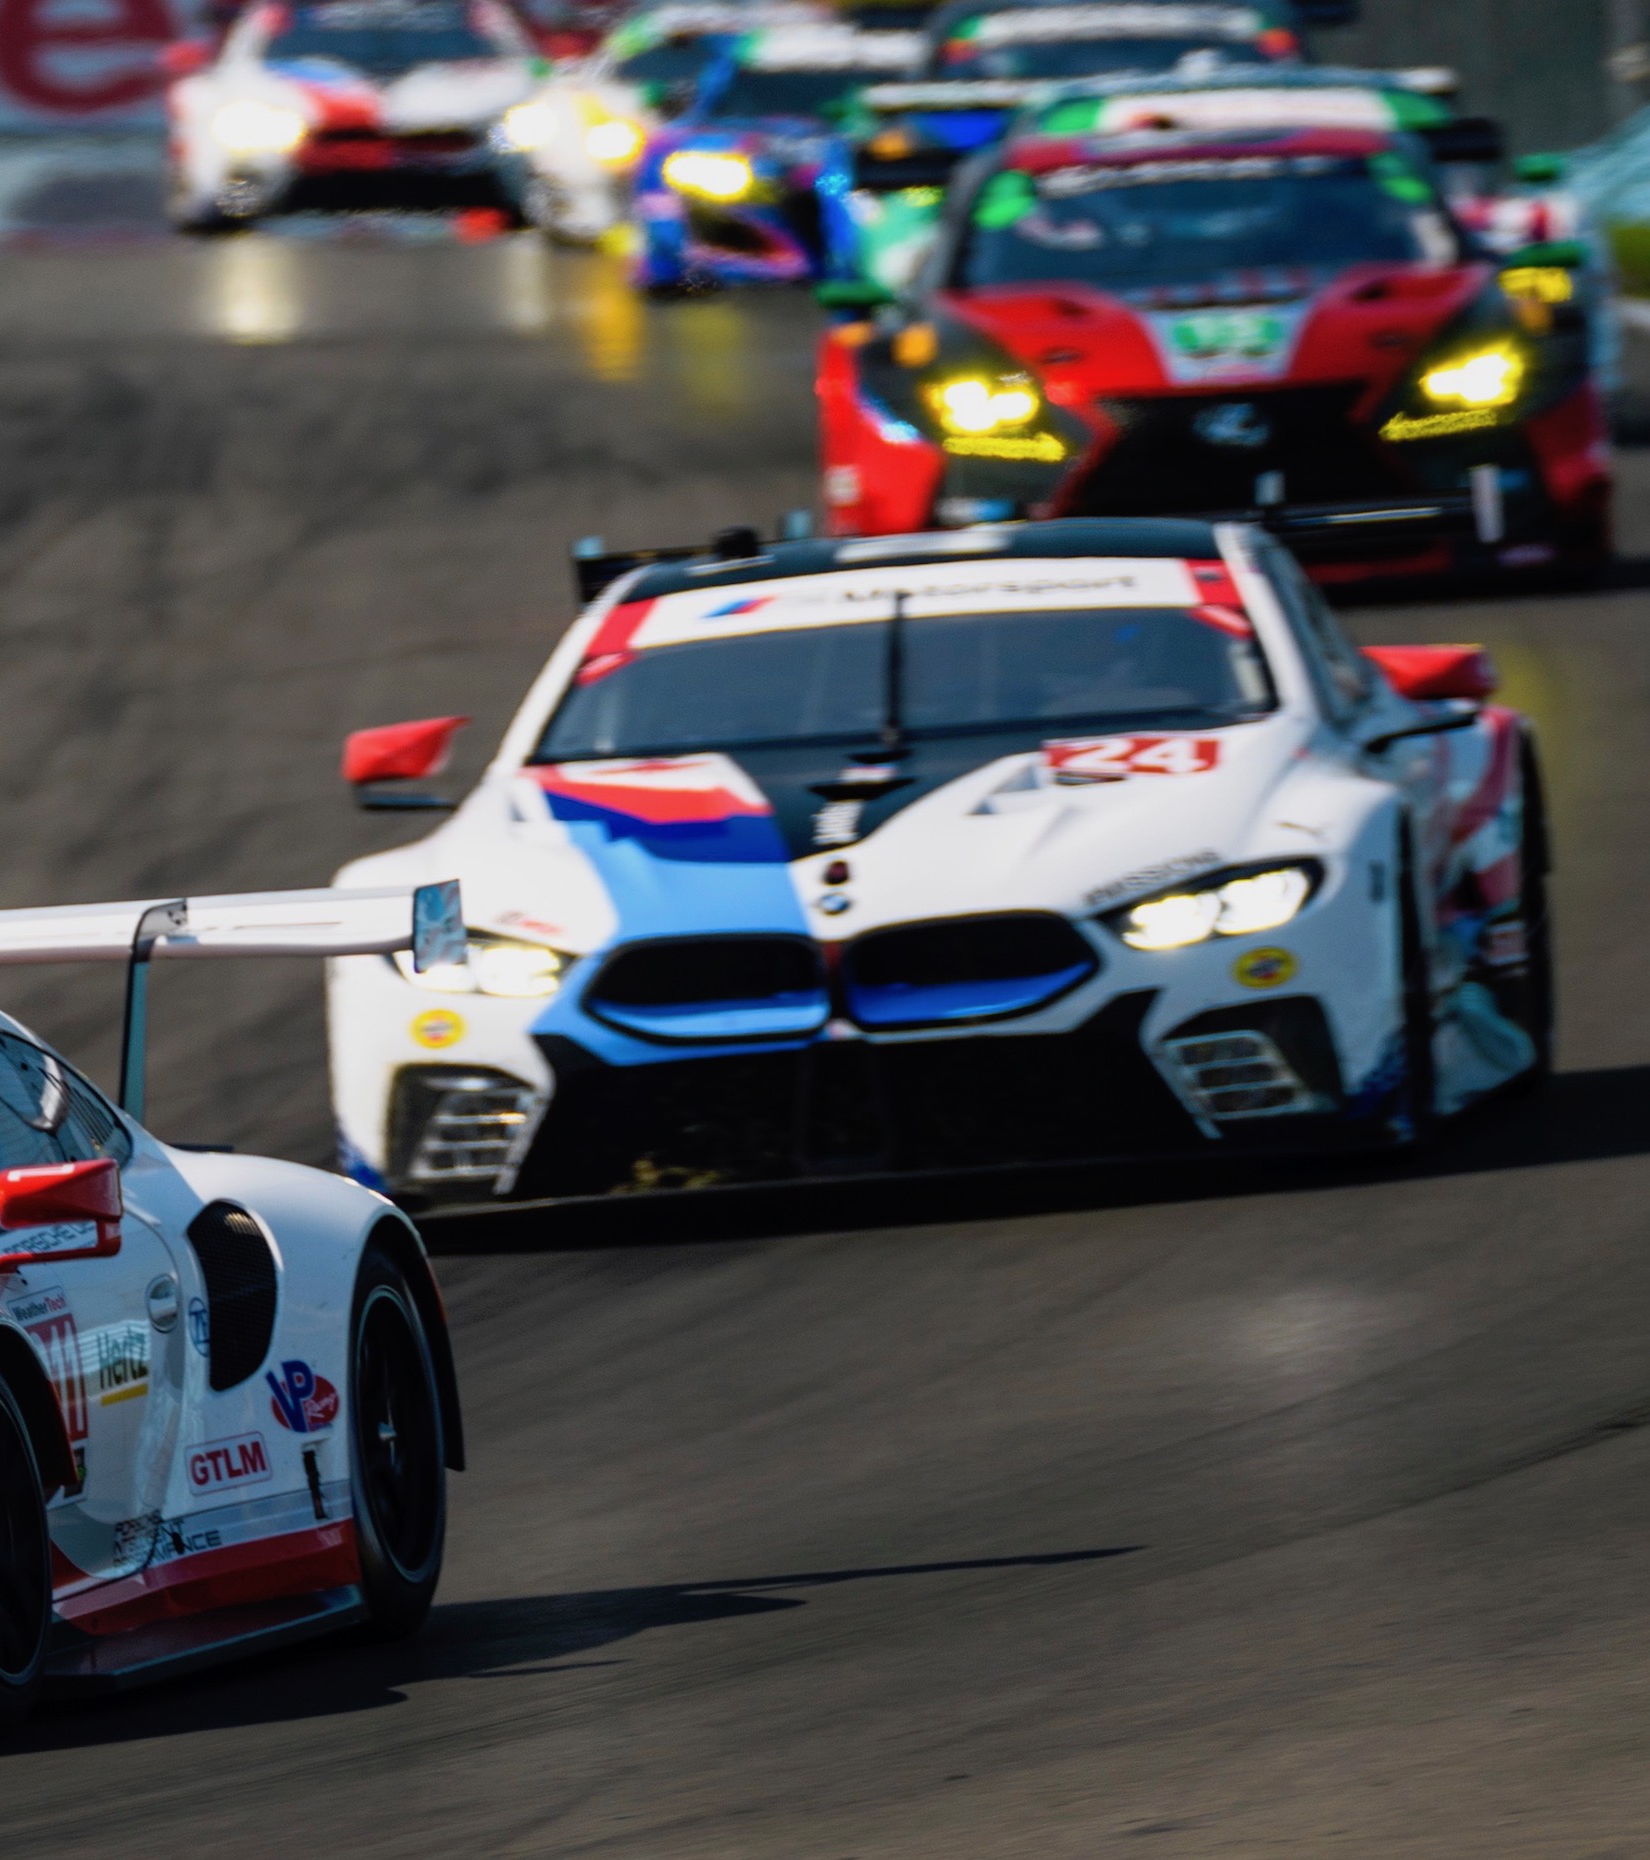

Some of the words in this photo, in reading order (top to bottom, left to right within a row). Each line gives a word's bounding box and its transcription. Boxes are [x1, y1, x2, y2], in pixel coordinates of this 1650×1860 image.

[1056, 737, 1210, 773] 24
[97, 1325, 148, 1390] Hertz
[265, 1360, 313, 1433] VP
[190, 1440, 267, 1486] GTLM
